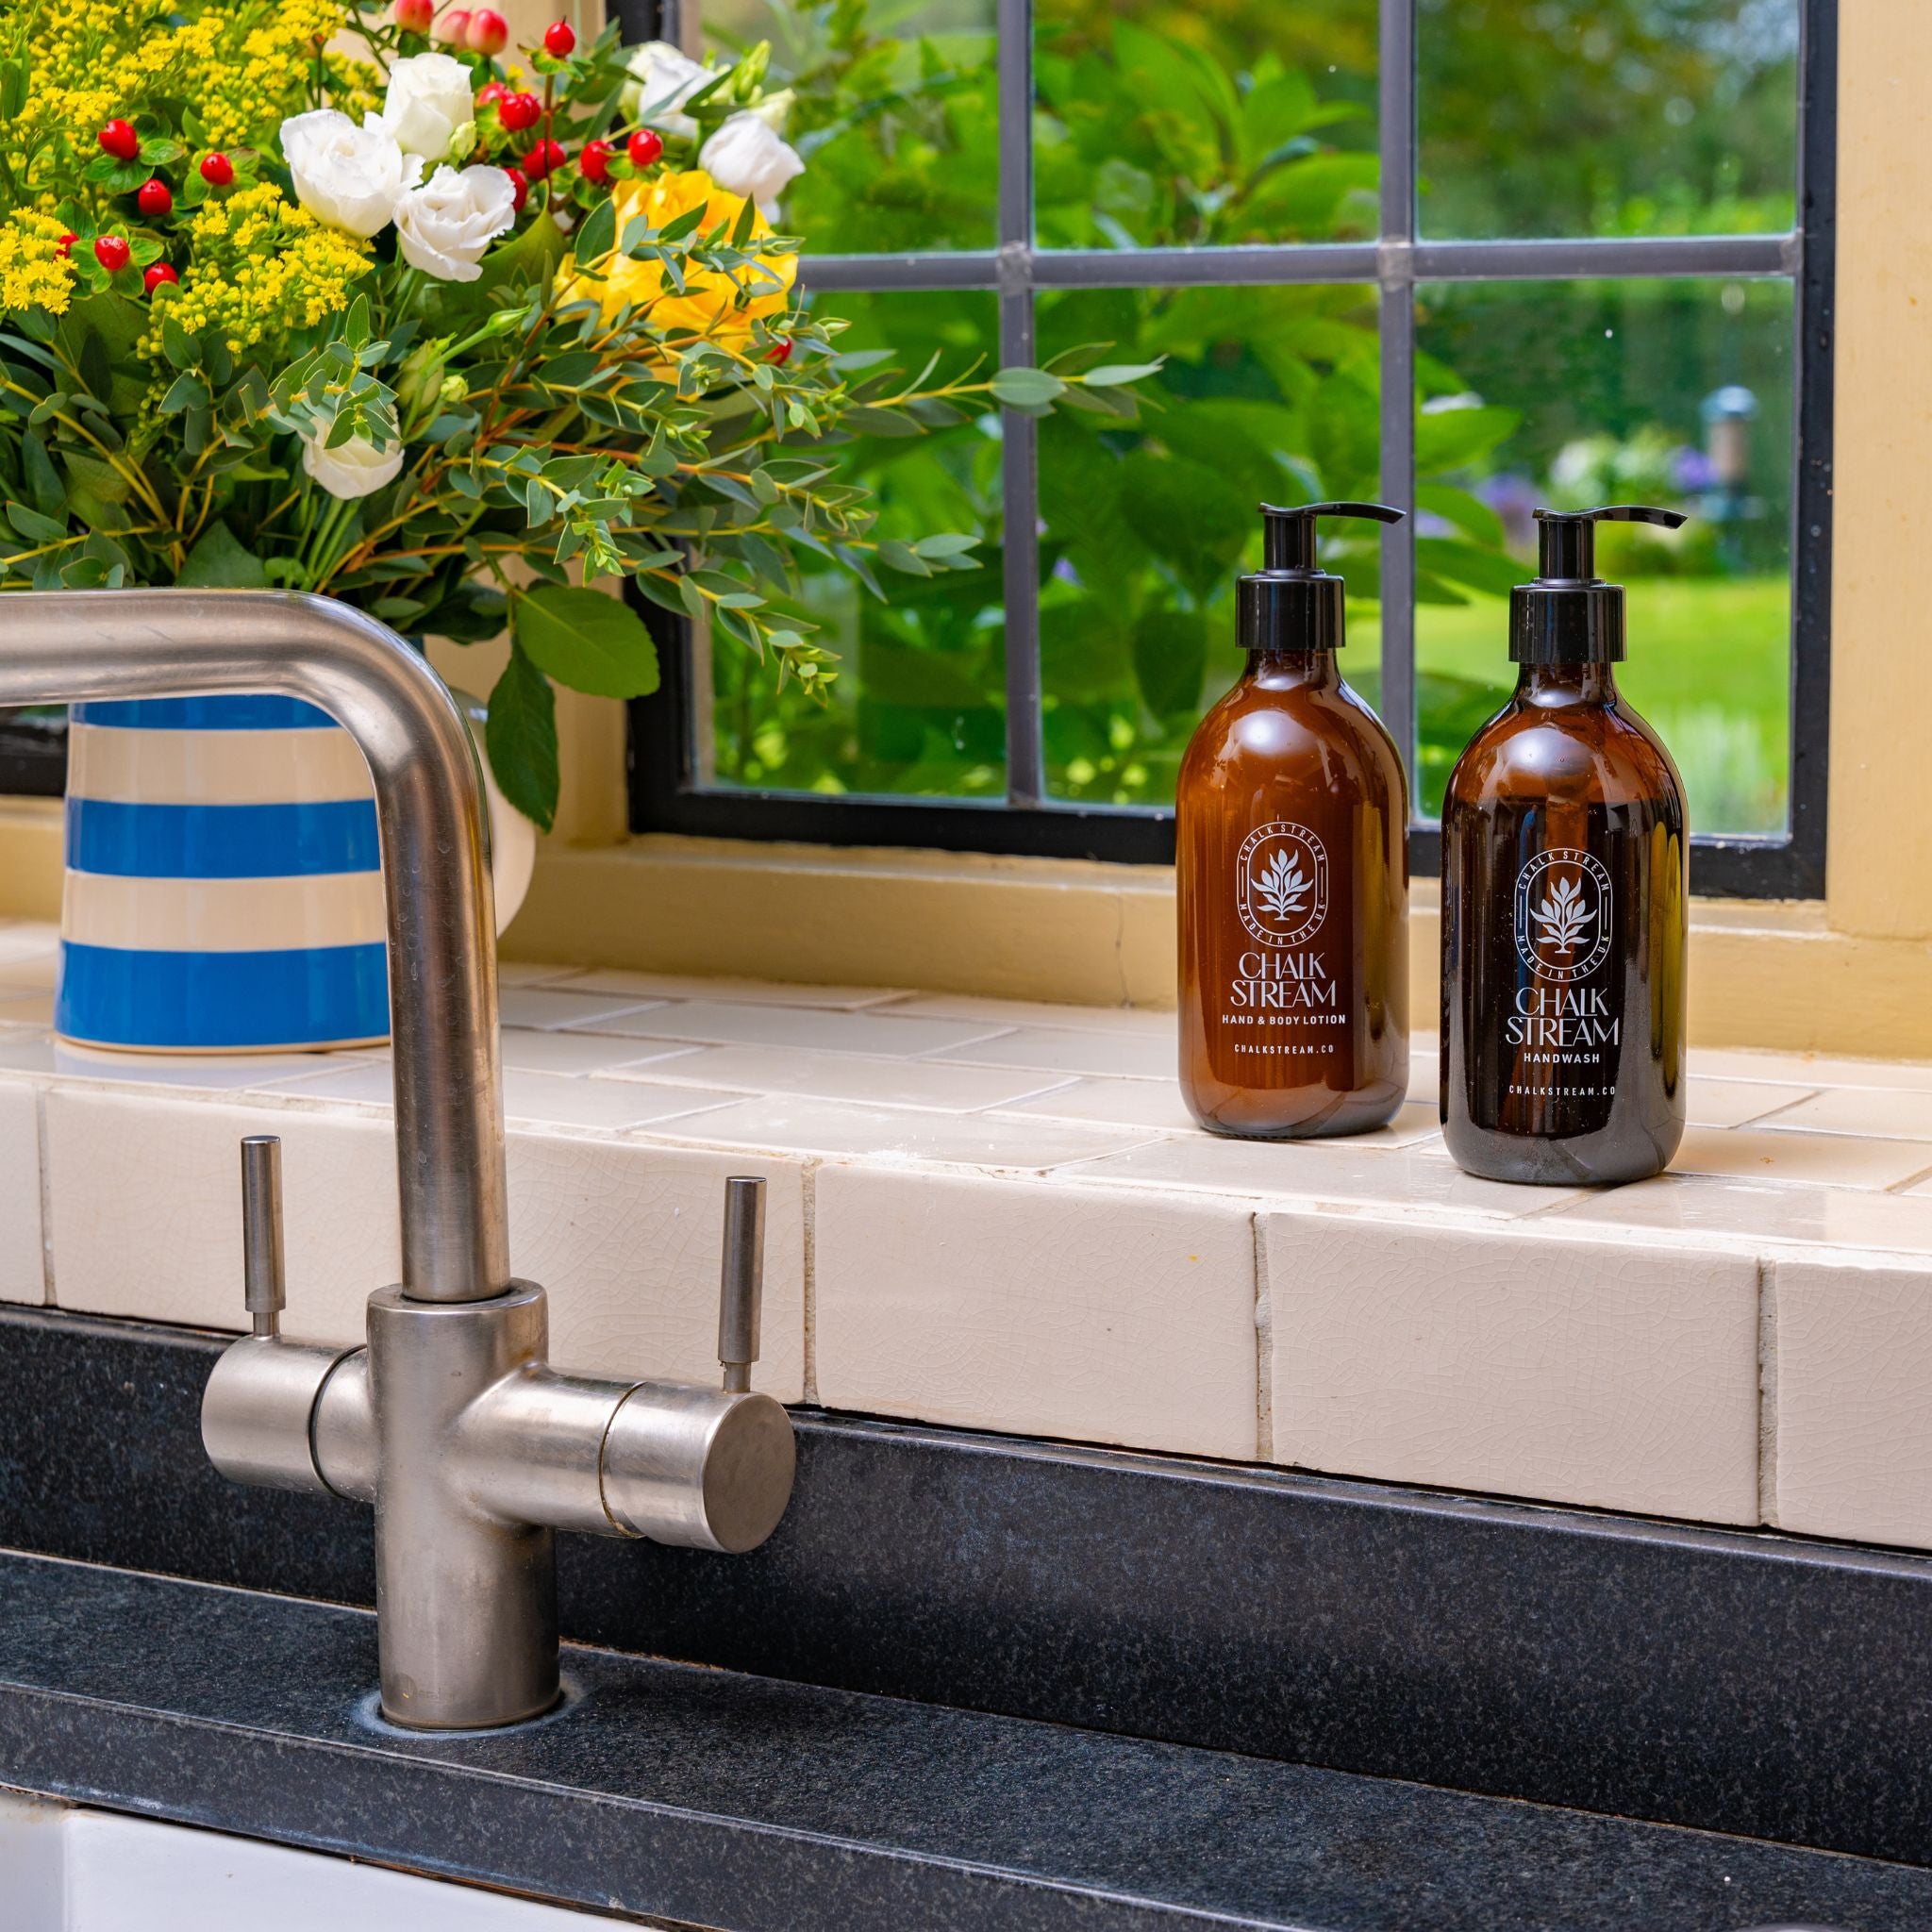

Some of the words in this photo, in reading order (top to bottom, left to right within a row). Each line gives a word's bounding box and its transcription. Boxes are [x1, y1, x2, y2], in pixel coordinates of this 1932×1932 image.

[1240, 825, 1274, 861] CHALK
[1280, 824, 1325, 862] STREAM
[1518, 852, 1555, 890] CHALK
[1562, 850, 1610, 891] STREAM
[1239, 903, 1264, 939] MADE
[1268, 936, 1284, 945] IN
[1290, 924, 1315, 943] THE
[1314, 903, 1326, 921] UK
[1238, 951, 1327, 980] CHALK
[1517, 935, 1543, 973] MADE
[1548, 969, 1564, 980] IN
[1572, 958, 1598, 978] THE
[1597, 935, 1609, 955] UK
[1229, 978, 1336, 1008] STREAM
[1515, 987, 1609, 1017] CHALK
[1222, 1014, 1254, 1024] HAND
[1257, 1015, 1265, 1025] &
[1269, 1015, 1300, 1025] BODY
[1303, 1014, 1346, 1025] LOTION
[1505, 1016, 1619, 1047] STREAM
[1234, 1043, 1334, 1055] CHALKSTREAM.CO
[1524, 1052, 1600, 1064] HANDWASH
[1508, 1085, 1616, 1096] CHALKSTREAM.CO
